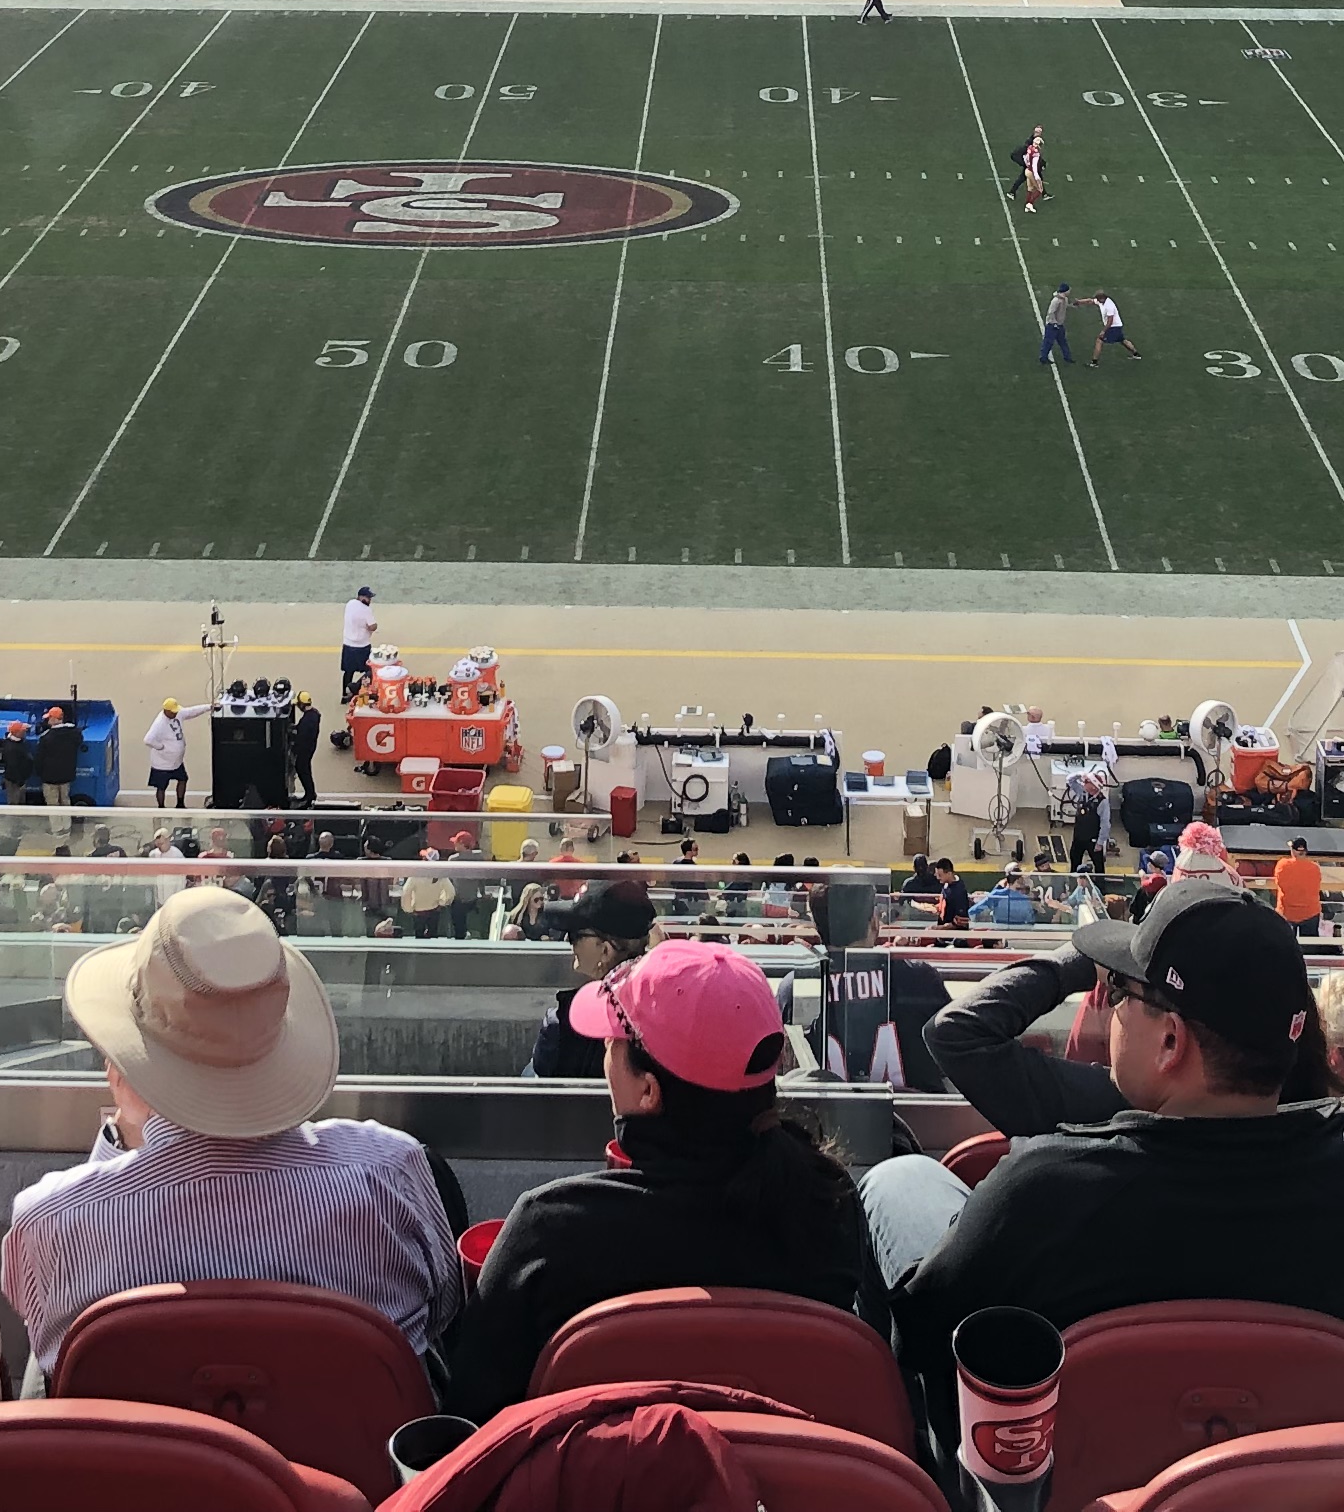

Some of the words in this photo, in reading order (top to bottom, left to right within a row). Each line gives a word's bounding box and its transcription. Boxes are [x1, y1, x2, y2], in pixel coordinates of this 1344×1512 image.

[314, 338, 459, 370] 50
[760, 343, 899, 375] 40
[385, 685, 397, 697] G
[457, 686, 468, 699] G
[367, 723, 395, 754] G
[462, 737, 484, 750] NFL
[412, 776, 426, 791] G
[828, 969, 885, 1002] YTON
